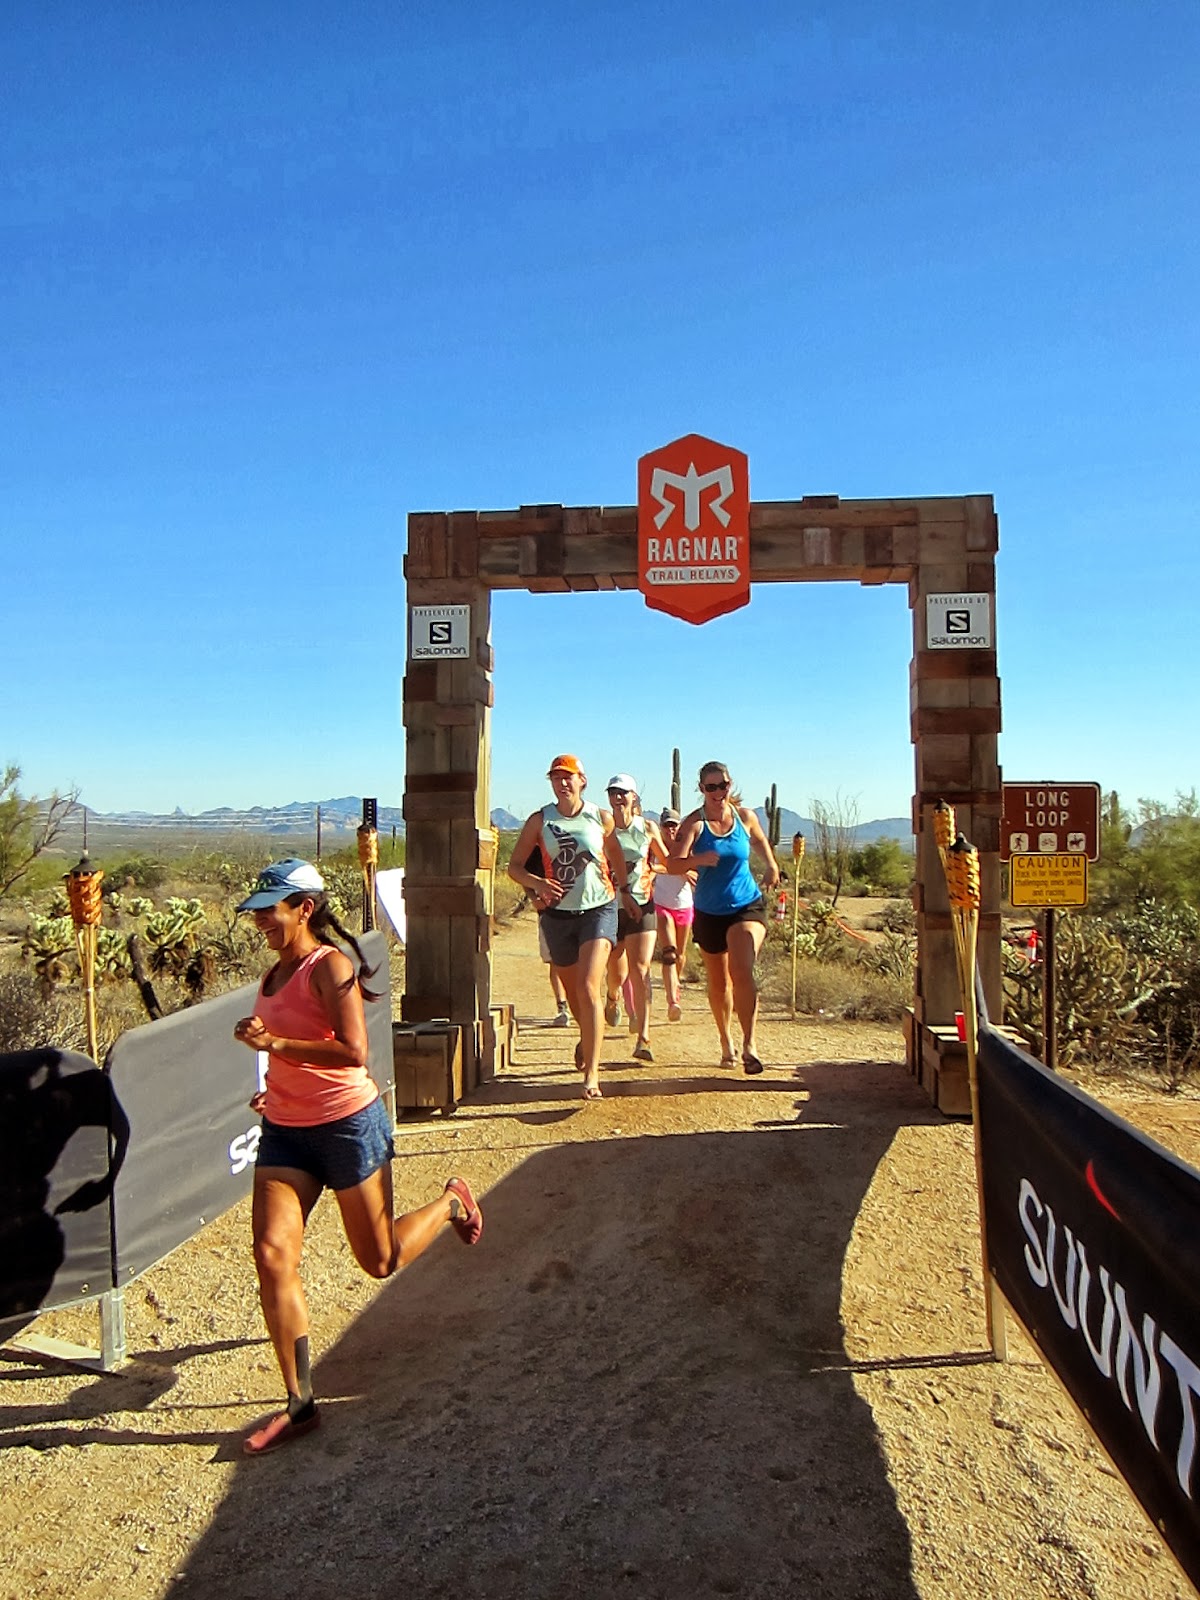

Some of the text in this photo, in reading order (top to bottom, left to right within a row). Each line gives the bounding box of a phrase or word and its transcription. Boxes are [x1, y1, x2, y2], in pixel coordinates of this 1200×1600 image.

[647, 536, 738, 562] RAGNAR
[651, 568, 735, 581] TRAIL RELAYS
[929, 597, 973, 605] PRESENTED
[1025, 791, 1070, 807] LONG
[1025, 810, 1070, 827] LOOP
[551, 824, 576, 893] iselle
[1017, 857, 1081, 868] CAUTION
